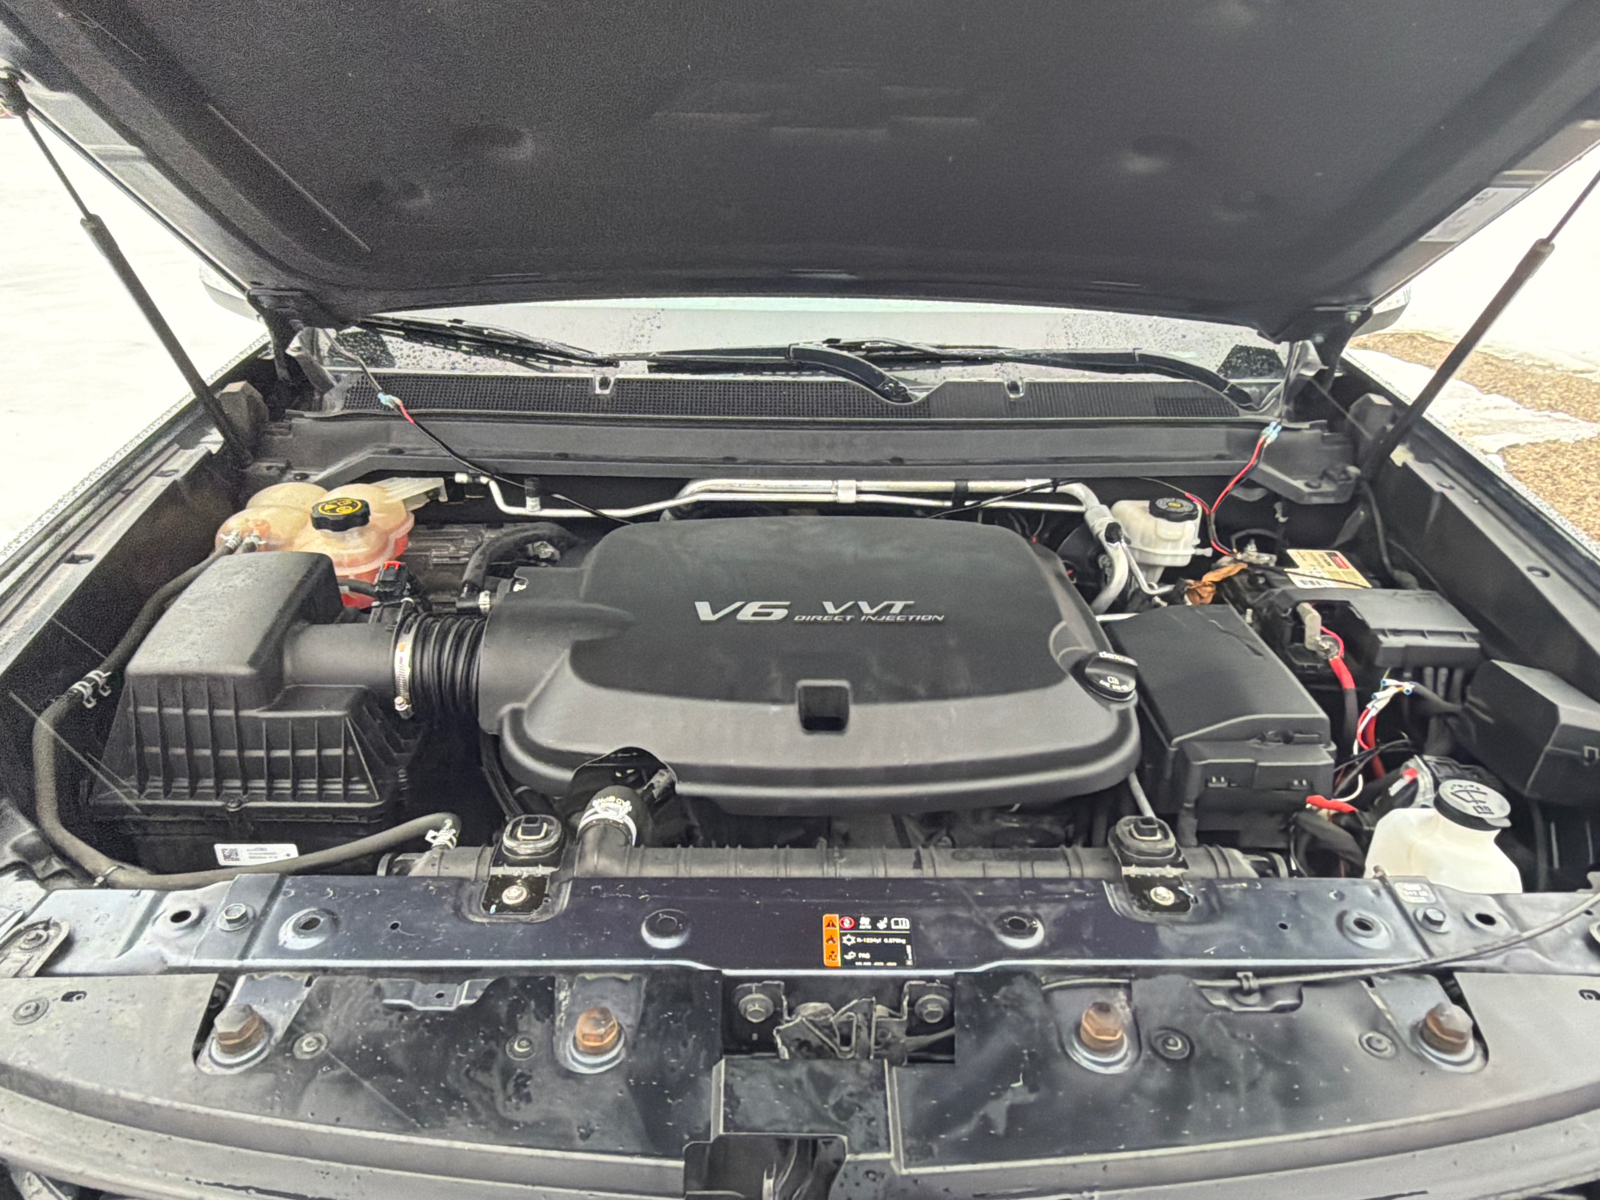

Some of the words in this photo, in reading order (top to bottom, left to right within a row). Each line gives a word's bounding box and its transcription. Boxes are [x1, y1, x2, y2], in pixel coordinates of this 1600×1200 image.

[694, 600, 791, 622] V6
[822, 600, 916, 615] VVT
[793, 614, 856, 622] DIRECT
[860, 614, 945, 623] INJECTION
